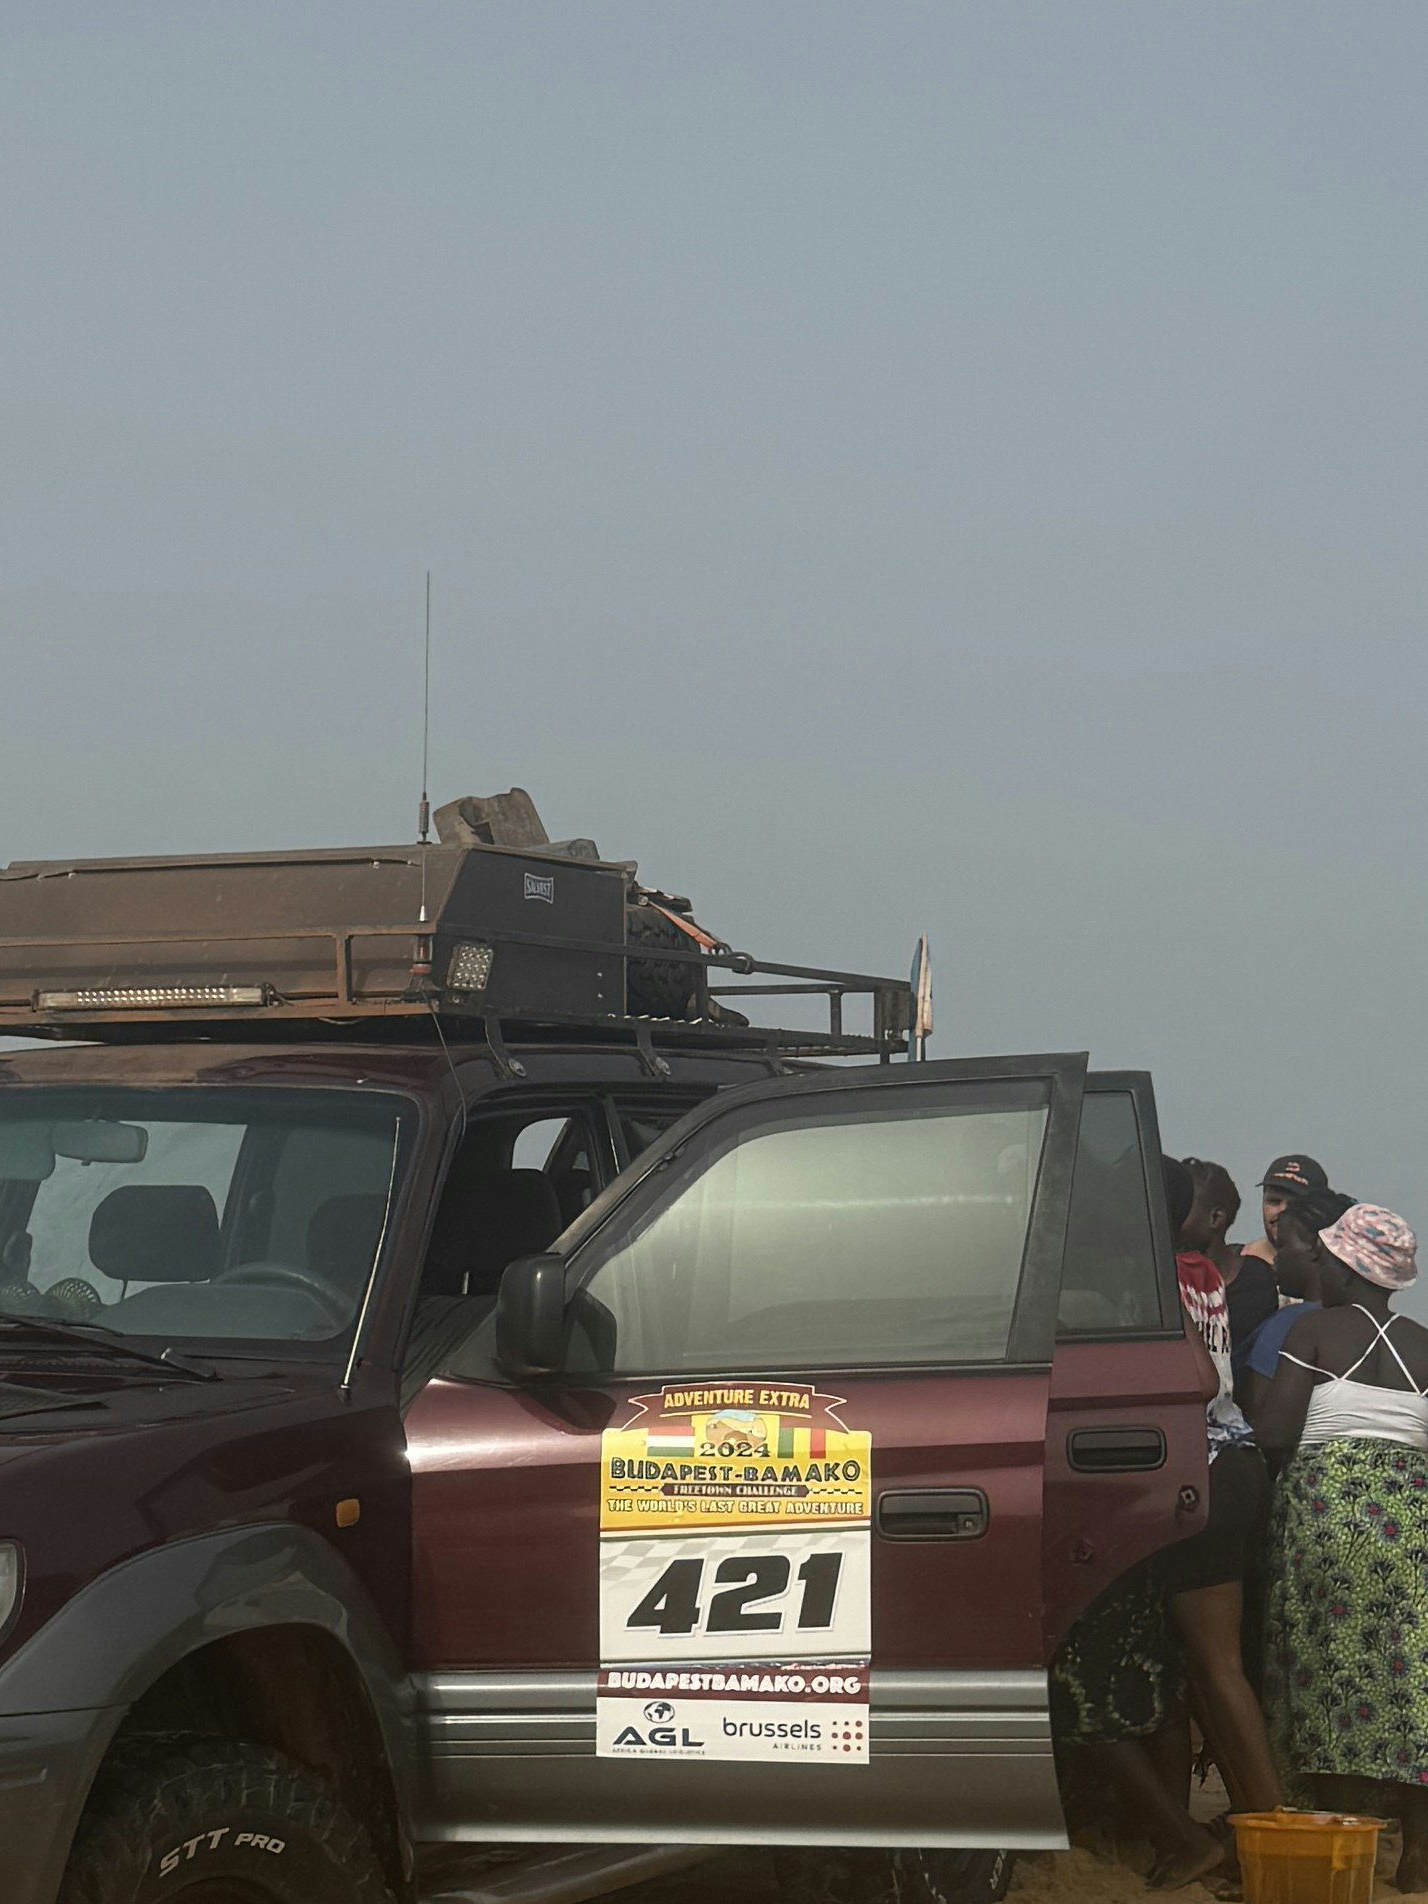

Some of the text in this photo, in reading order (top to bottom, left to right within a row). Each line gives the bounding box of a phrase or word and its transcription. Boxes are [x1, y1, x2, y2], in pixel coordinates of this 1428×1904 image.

[664, 1389, 810, 1409] ADVENTURE EXTRA
[699, 1441, 771, 1457] 2024
[611, 1456, 861, 1482] BUDAPEST-BAMAKO
[673, 1483, 798, 1496] FREETOWN CHALLENGE
[607, 1498, 864, 1514] THE WORLD'S LAST GREAT ADVENTURE
[626, 1552, 844, 1635] 421
[607, 1671, 862, 1694] BUDAPESTBAMAKO.ORG
[612, 1726, 705, 1747] AGL
[722, 1717, 822, 1739] brussels
[772, 1743, 822, 1751] AIRLINES
[159, 1827, 286, 1877] STT PRO
